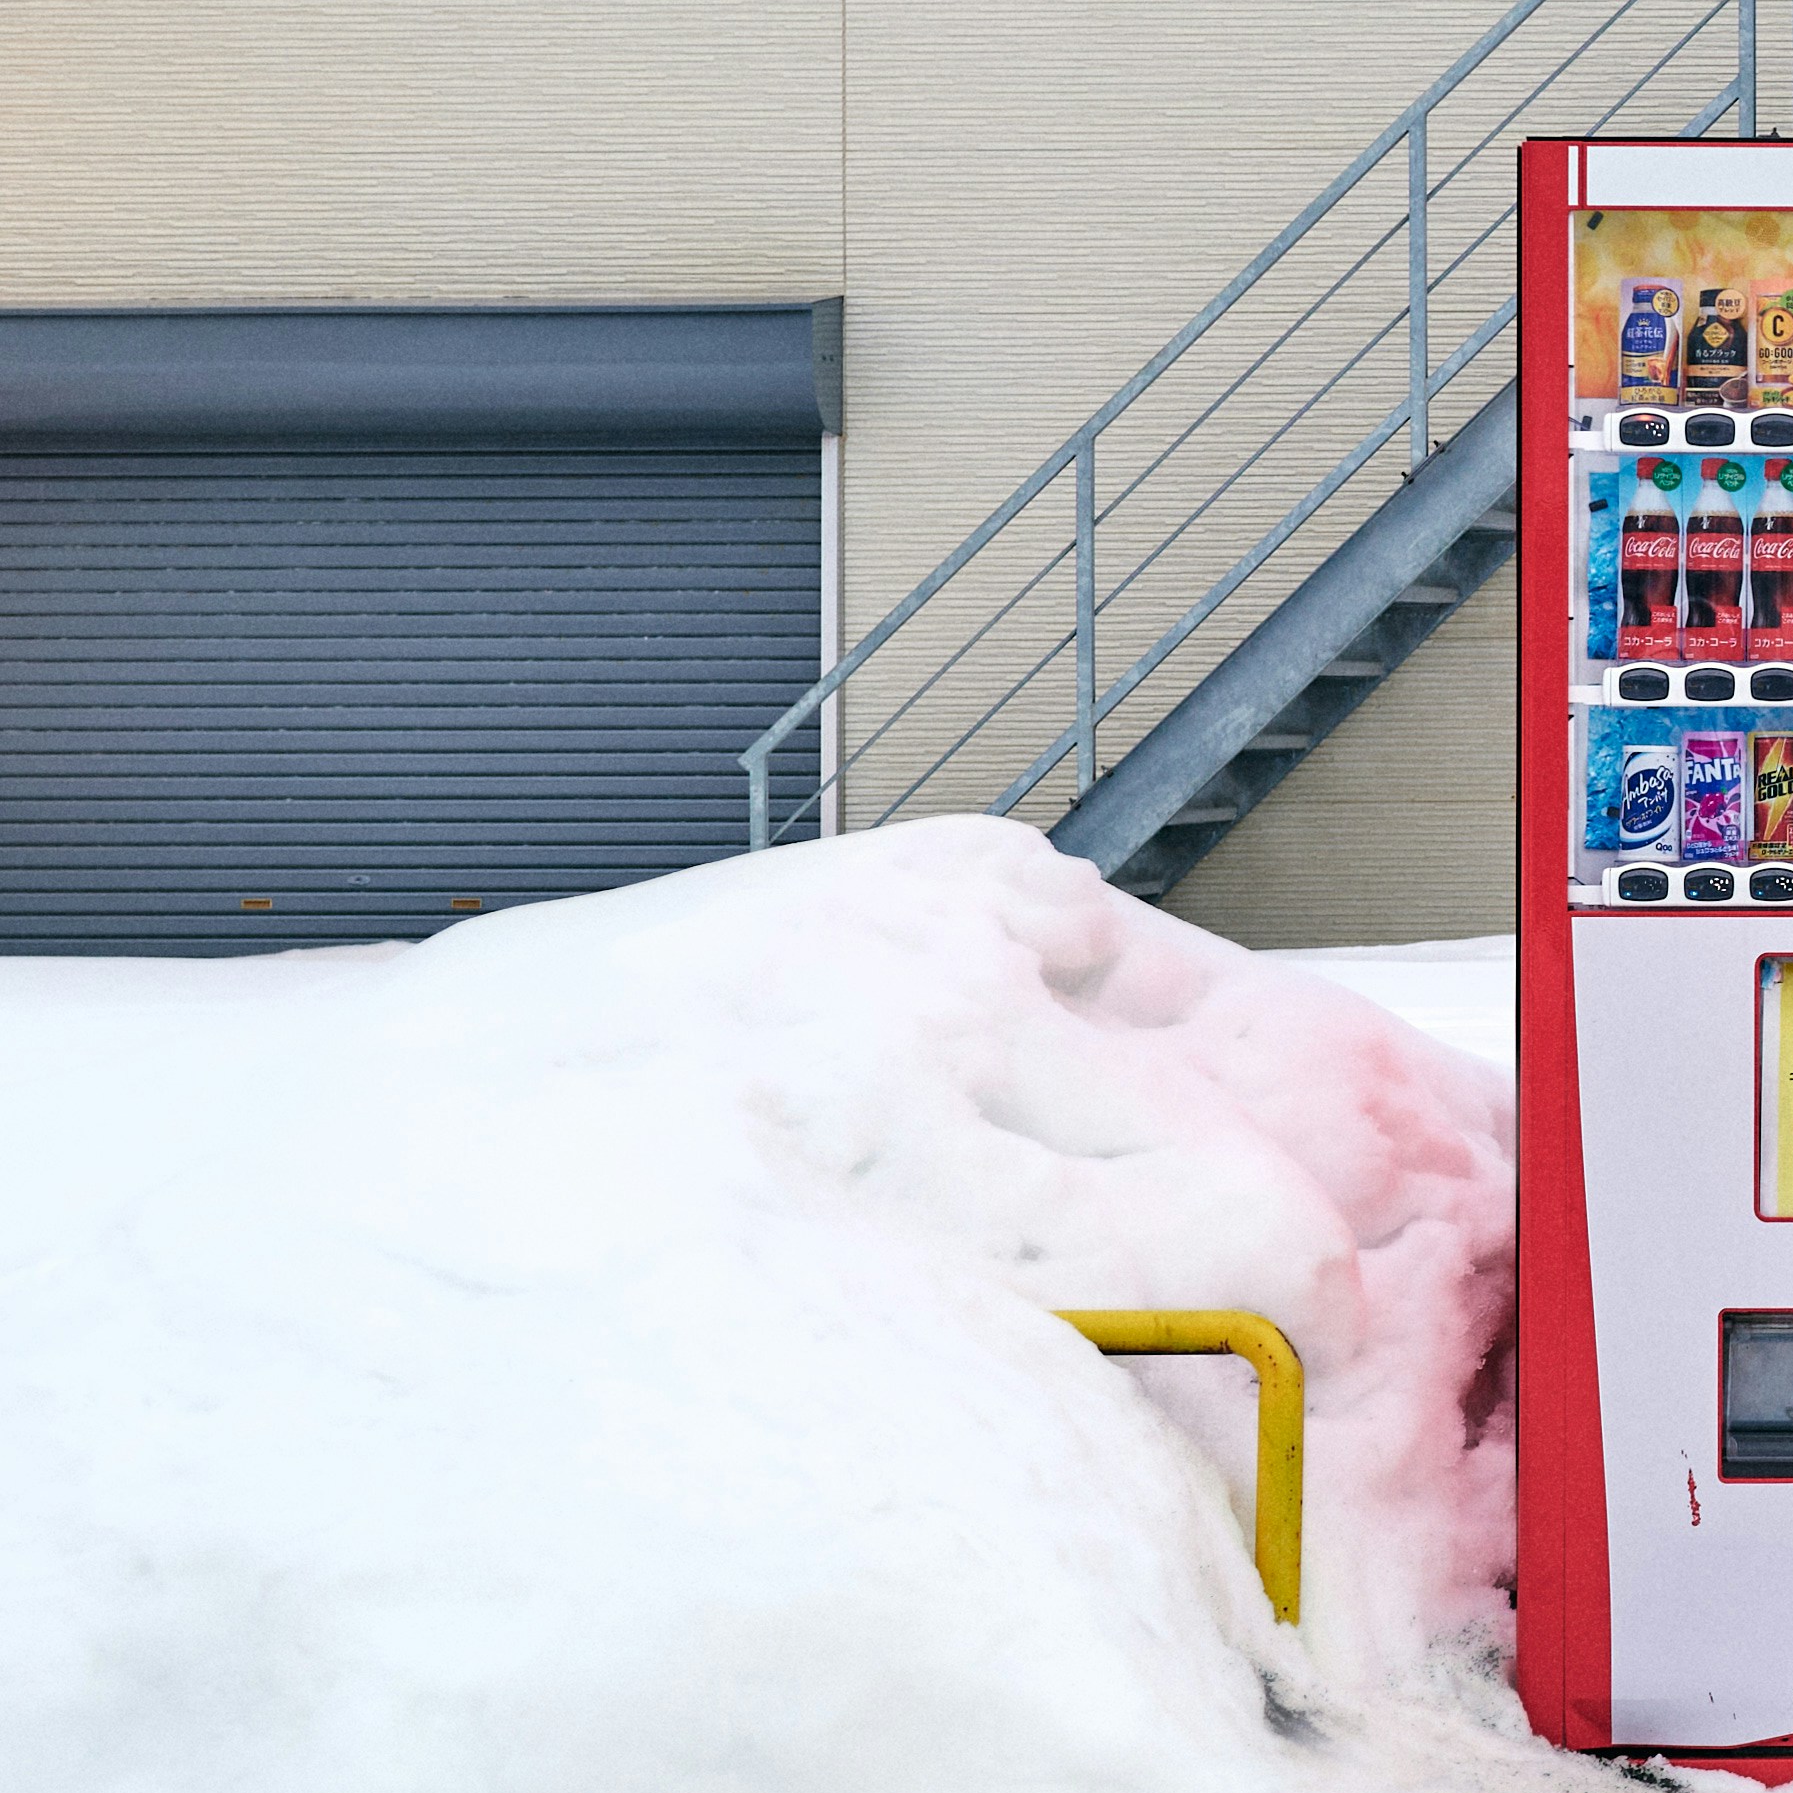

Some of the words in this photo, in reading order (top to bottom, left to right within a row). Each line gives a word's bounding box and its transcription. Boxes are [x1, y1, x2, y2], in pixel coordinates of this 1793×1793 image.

[1773, 315, 1784, 337] C
[1624, 537, 1677, 560] Coca-Cola
[1688, 537, 1741, 560] Coca-Cola
[1623, 637, 1673, 646] コカ・コーラ
[1688, 637, 1738, 647] コカ・コーラ
[1655, 842, 1673, 852] Qoo
